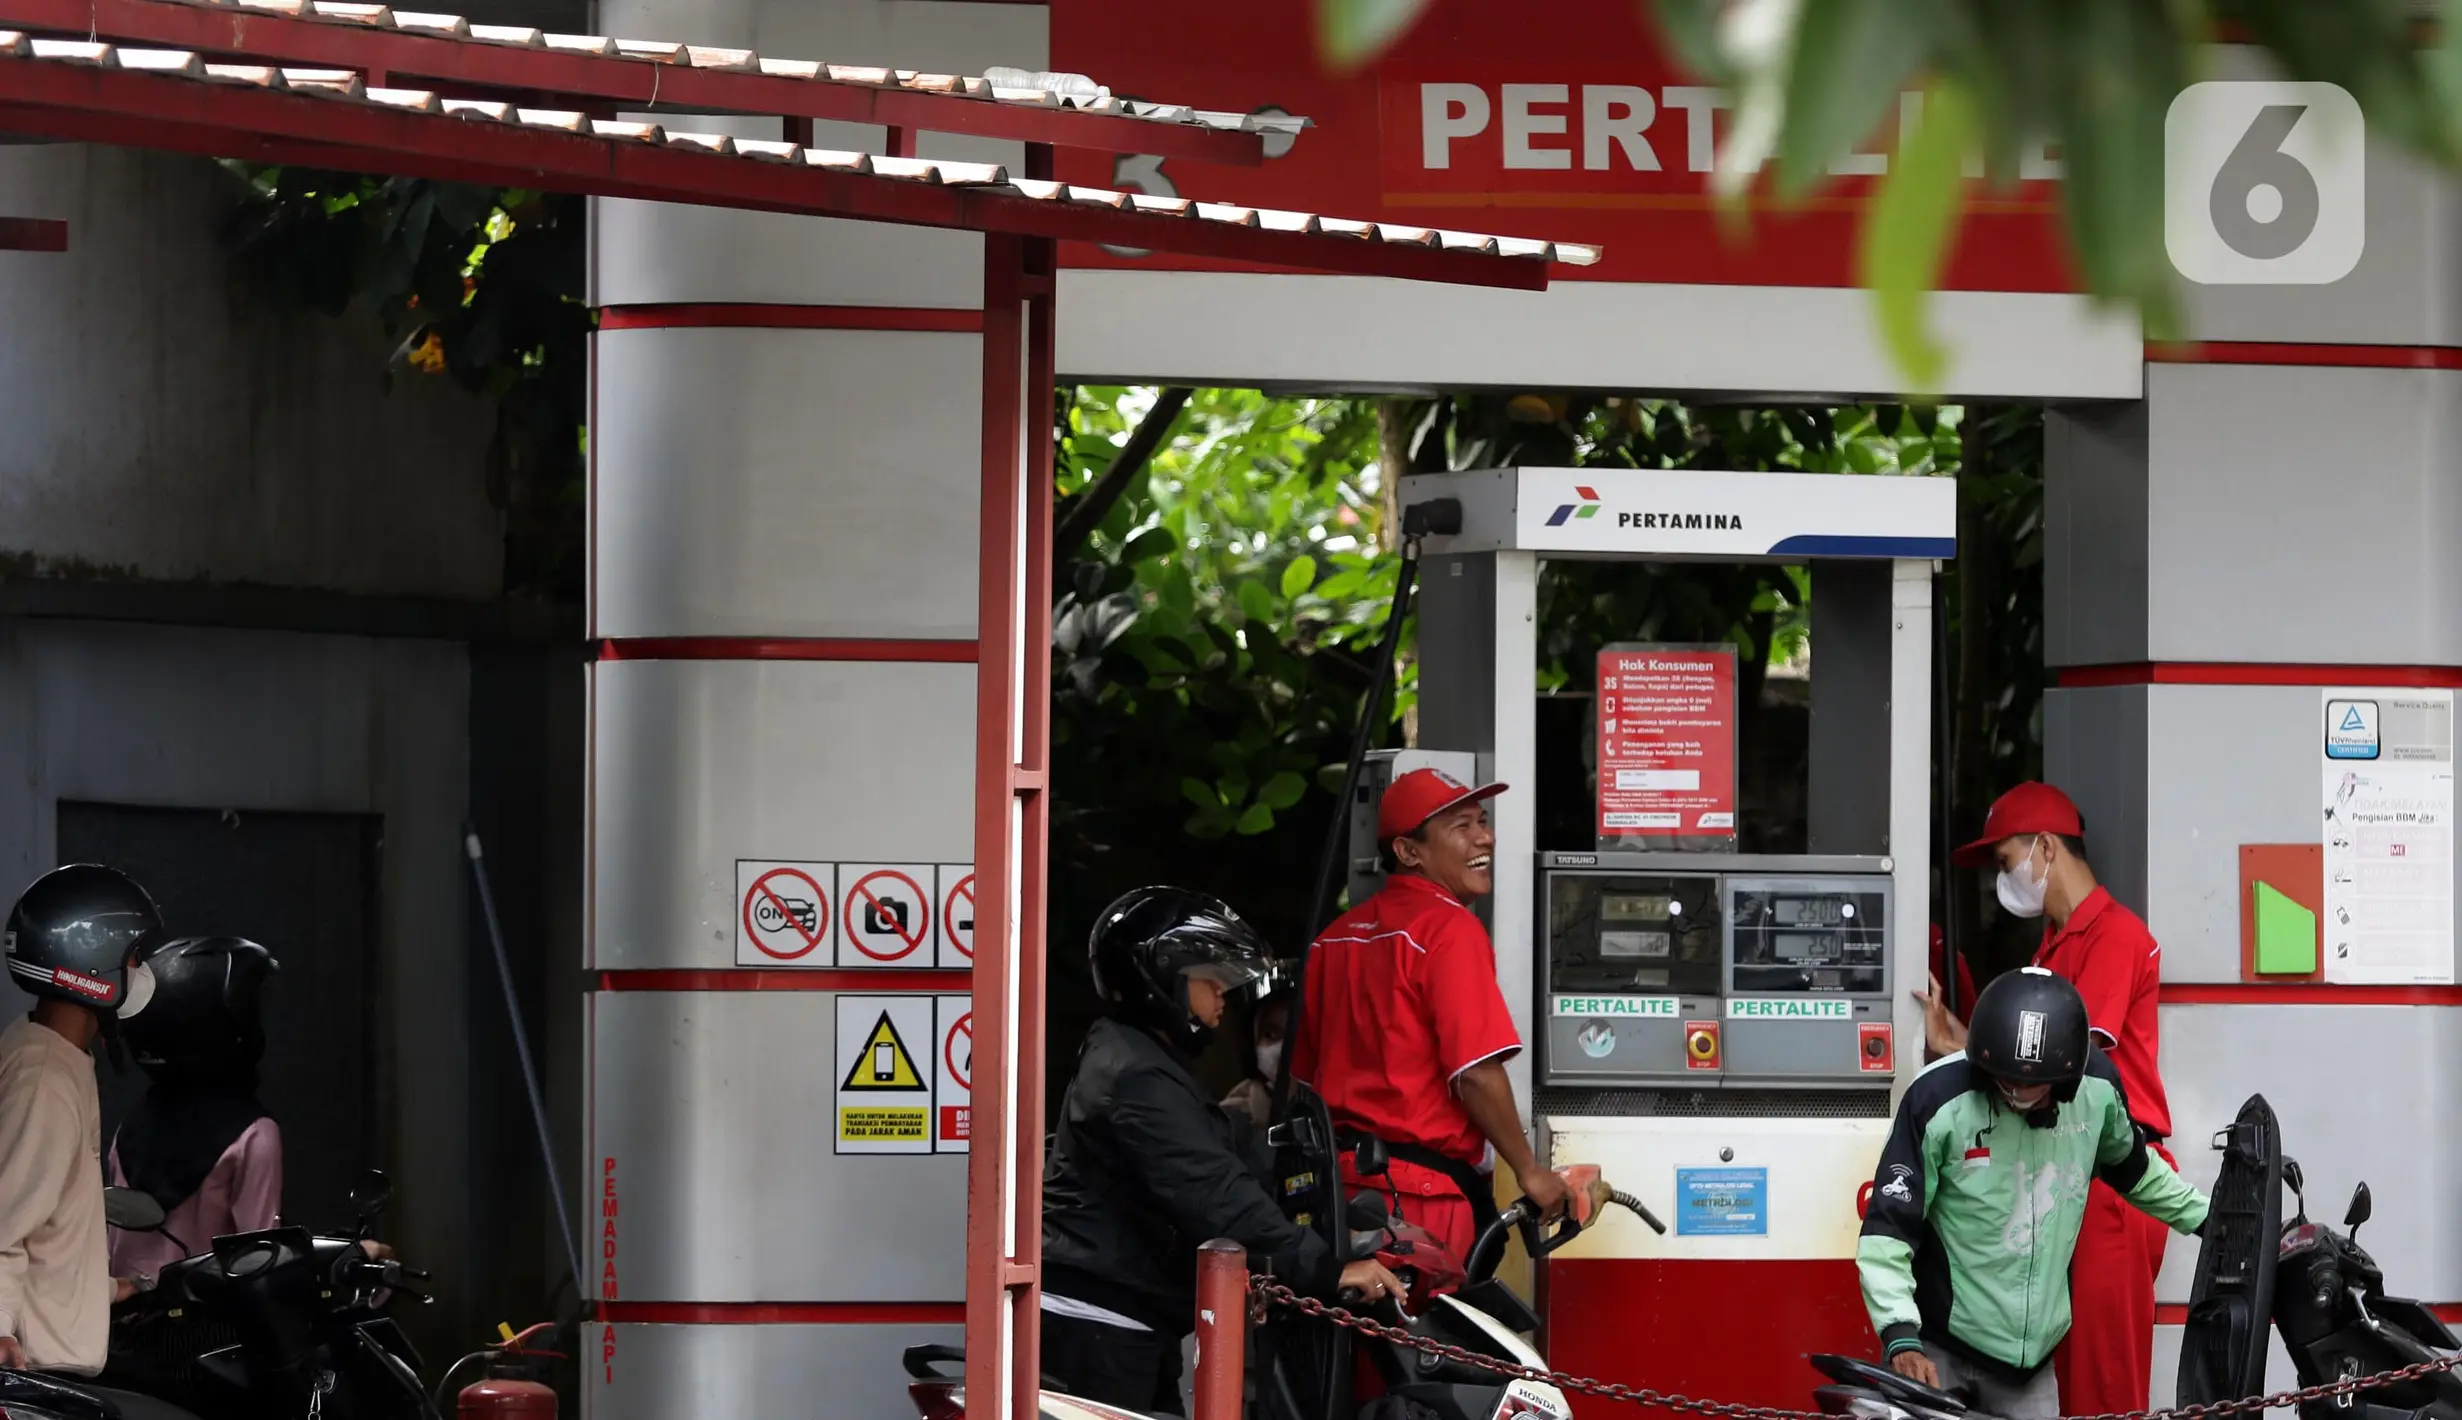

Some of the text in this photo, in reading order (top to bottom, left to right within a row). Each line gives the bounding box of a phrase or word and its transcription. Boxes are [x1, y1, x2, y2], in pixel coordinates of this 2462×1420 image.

[1618, 511, 1743, 531] PERTAMINA
[1619, 659, 1714, 672] Hak Konsumen
[2352, 813, 2394, 824] Pengisian
[760, 908, 783, 919] ON
[1559, 998, 1674, 1014] PERTALITE
[1732, 1001, 1847, 1016] PERTALITE
[845, 1128, 922, 1136] PADA JARAK AMAN
[603, 1157, 619, 1385] PEMADAM API
[1519, 1388, 1557, 1413] HONDA
